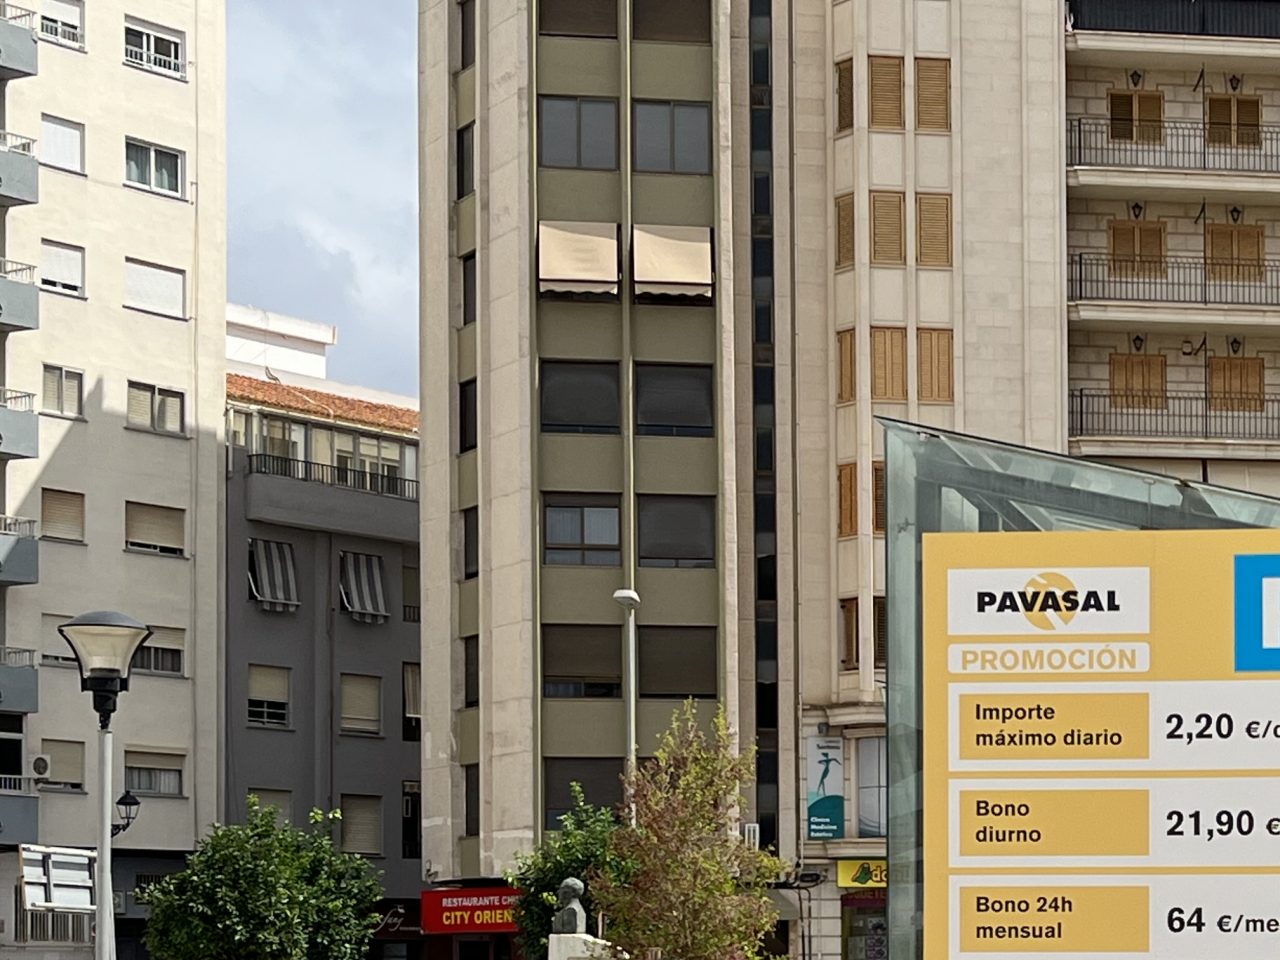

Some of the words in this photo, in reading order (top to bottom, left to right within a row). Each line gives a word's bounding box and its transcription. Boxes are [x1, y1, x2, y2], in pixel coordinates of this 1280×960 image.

[976, 590, 1120, 613] PAVASAL
[961, 644, 1137, 671] PROMOCIÓN
[975, 704, 1055, 724] Importe
[975, 729, 1056, 747] máximo
[1063, 729, 1123, 746] diario
[1166, 713, 1234, 745] 2,20
[975, 800, 1030, 817] Bono
[975, 827, 1041, 843] diurno
[1166, 811, 1255, 841] 21,90
[442, 896, 500, 907] RESTAURANTE
[975, 897, 1030, 913] Bono
[1036, 896, 1072, 913] 24h
[442, 912, 471, 925] CITY
[474, 910, 513, 923] ORIEN
[1167, 907, 1206, 933] 64
[975, 923, 1062, 939] mensual
